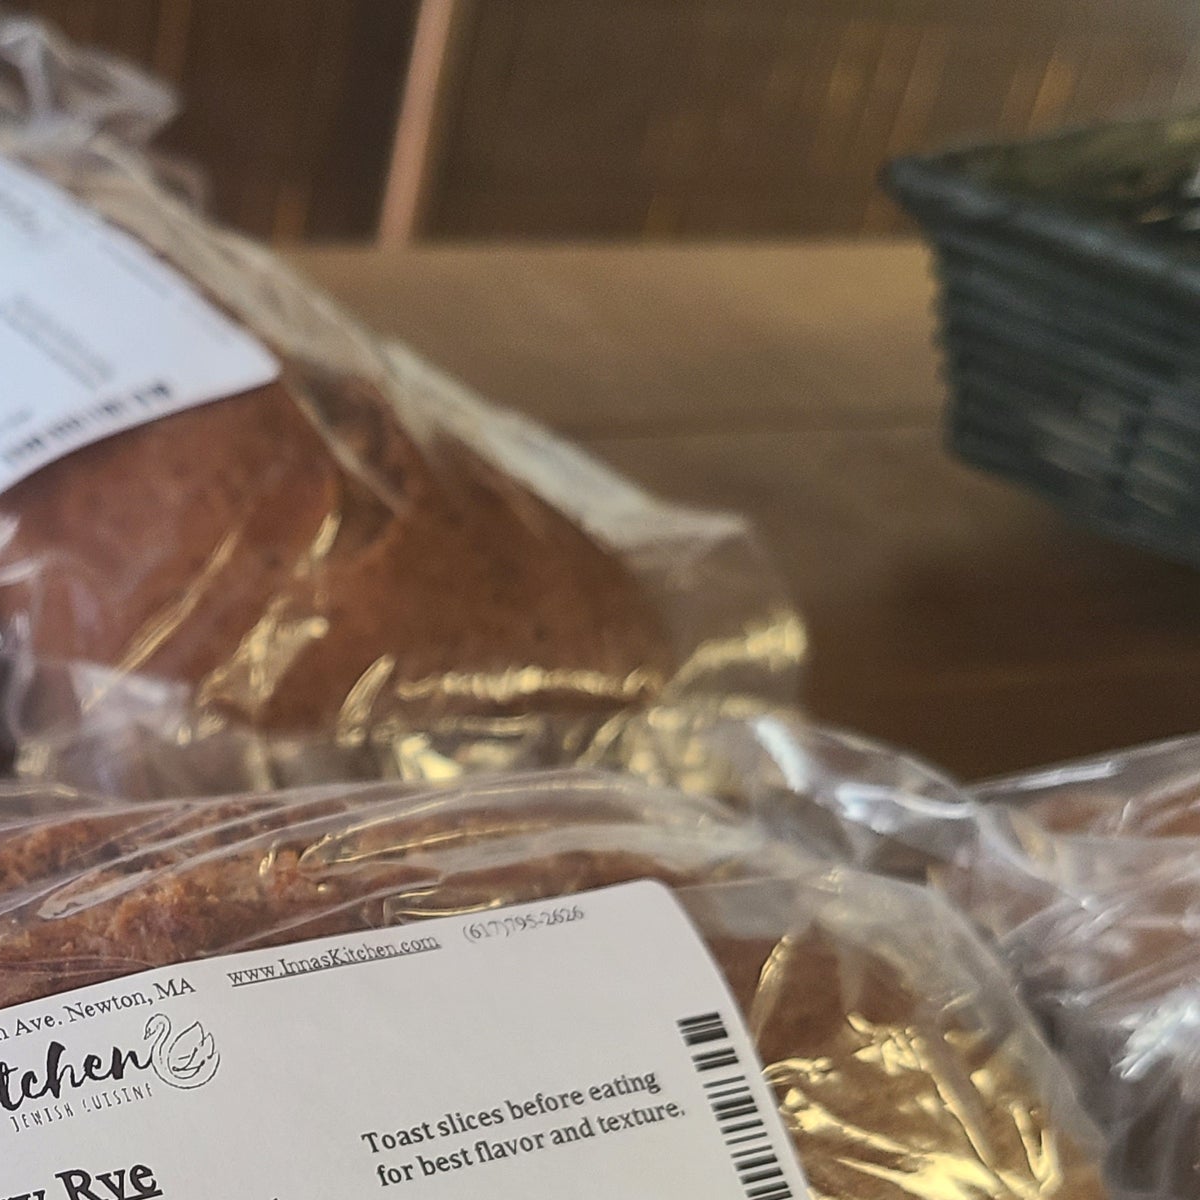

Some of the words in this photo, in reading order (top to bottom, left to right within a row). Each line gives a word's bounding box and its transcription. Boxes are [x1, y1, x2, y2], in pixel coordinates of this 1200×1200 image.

[462, 905, 585, 944] (617)795-2626
[226, 936, 442, 988] www.InnasKitchen.com
[15, 1015, 63, 1037] Ave.
[62, 992, 154, 1023] Newton,
[152, 977, 197, 1000] MA
[9, 1102, 74, 1133] JEWISH
[360, 1122, 436, 1154] Toast
[436, 1108, 505, 1137] slices
[503, 1090, 585, 1120] before
[588, 1072, 662, 1102] eating
[376, 1164, 414, 1187] for
[415, 1148, 474, 1177] best
[474, 1133, 545, 1163] flavor
[549, 1116, 596, 1146] and
[596, 1102, 686, 1134] texture.
